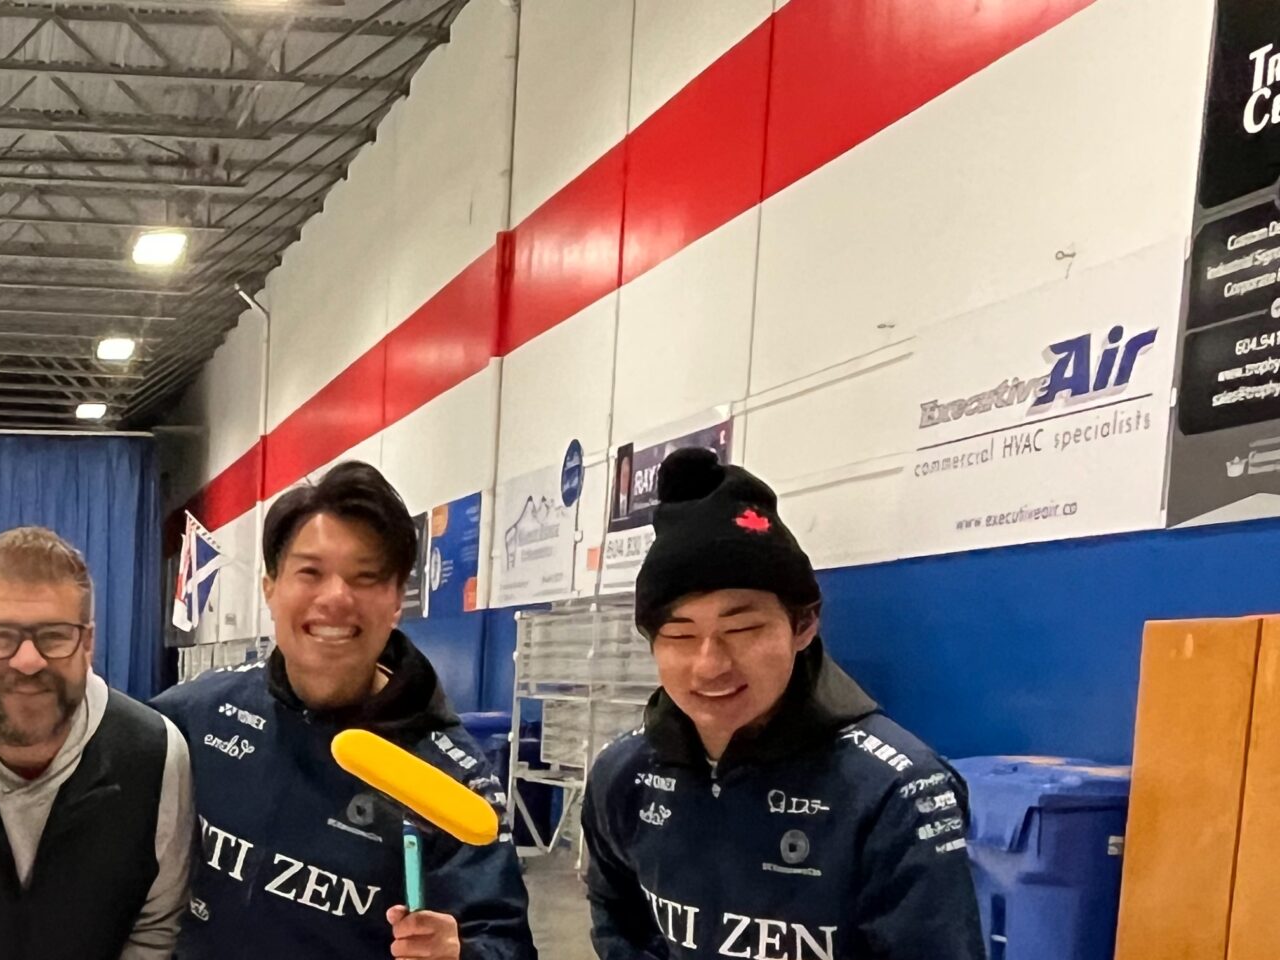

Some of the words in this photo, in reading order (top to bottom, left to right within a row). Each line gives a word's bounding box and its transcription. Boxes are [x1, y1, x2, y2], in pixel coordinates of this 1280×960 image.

[1032, 325, 1158, 406] Air
[914, 437, 995, 478] commercial
[1002, 428, 1044, 459] HVAC
[1053, 408, 1151, 451] specialists
[264, 853, 382, 916] ZEN
